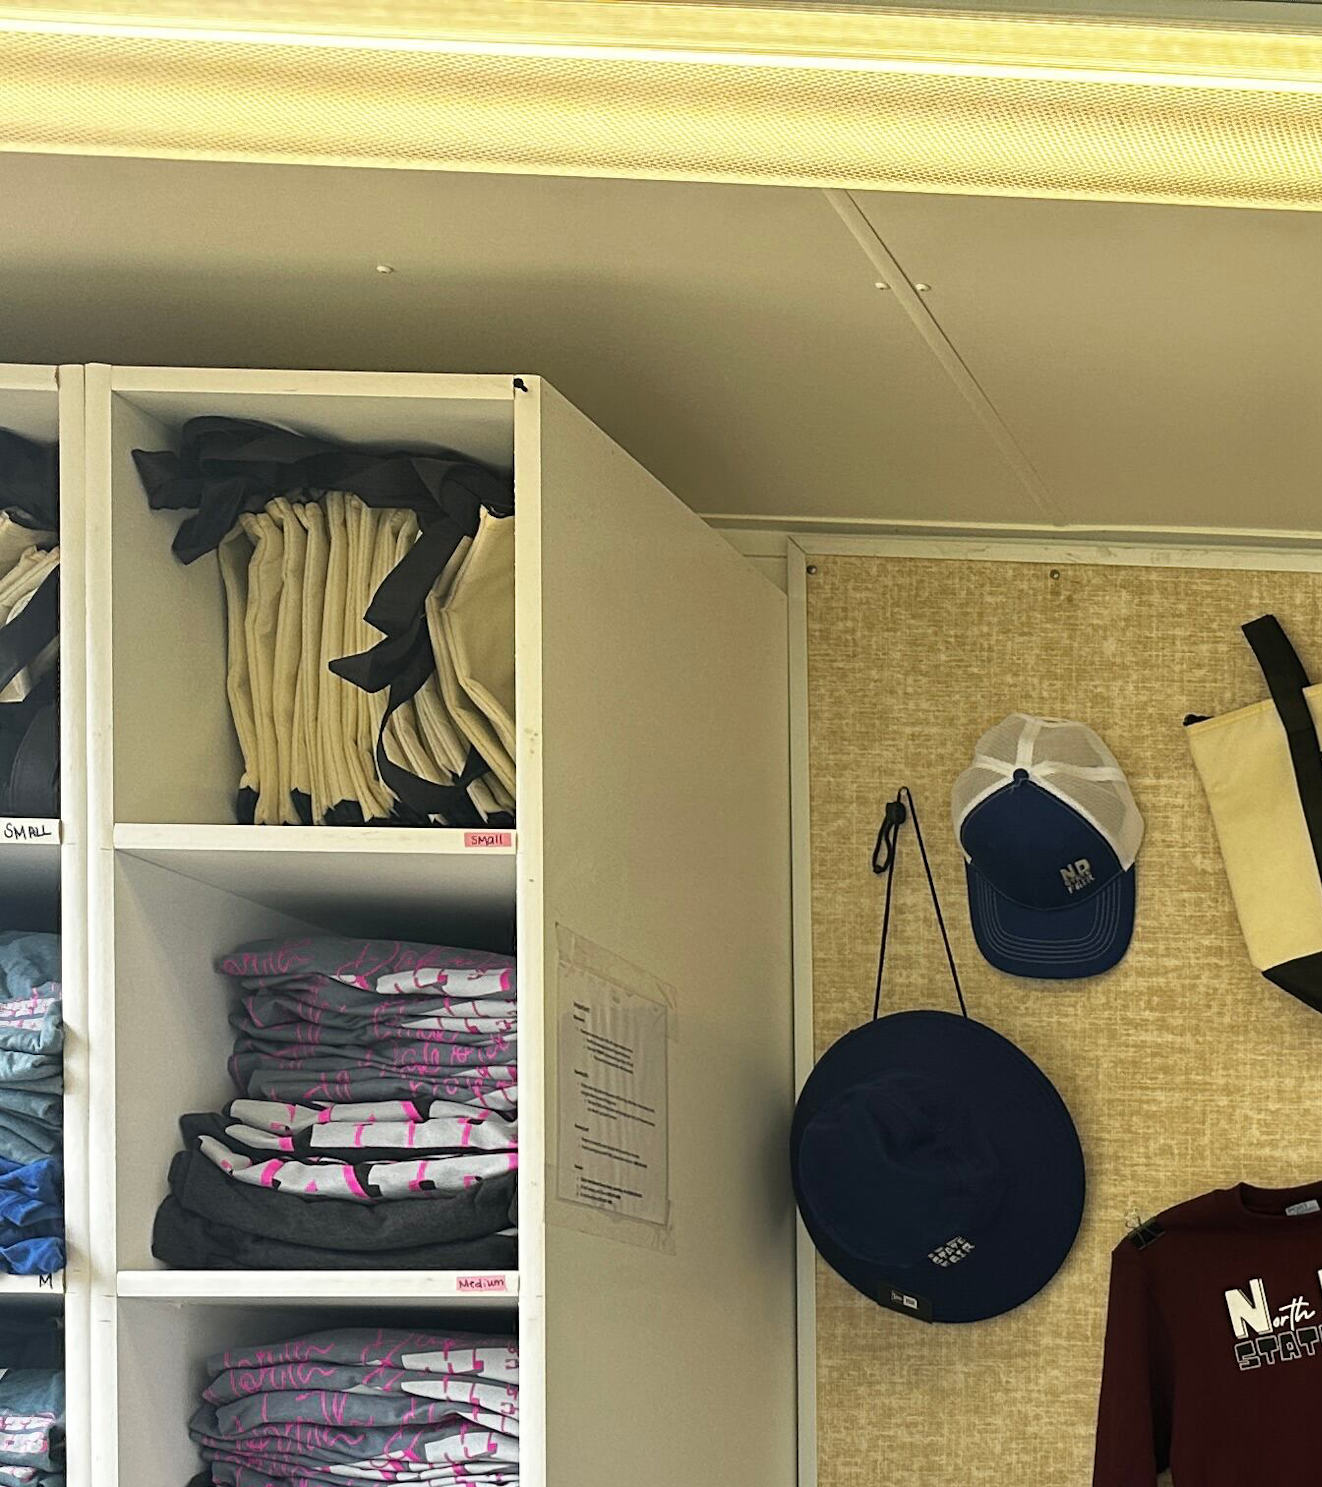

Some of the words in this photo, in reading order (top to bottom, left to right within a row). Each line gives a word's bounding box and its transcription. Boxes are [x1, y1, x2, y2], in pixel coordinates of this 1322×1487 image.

[4, 822, 52, 840] SMALL
[39, 1272, 53, 1290] M
[458, 1279, 504, 1289] Medium
[1224, 1277, 1316, 1340] North
